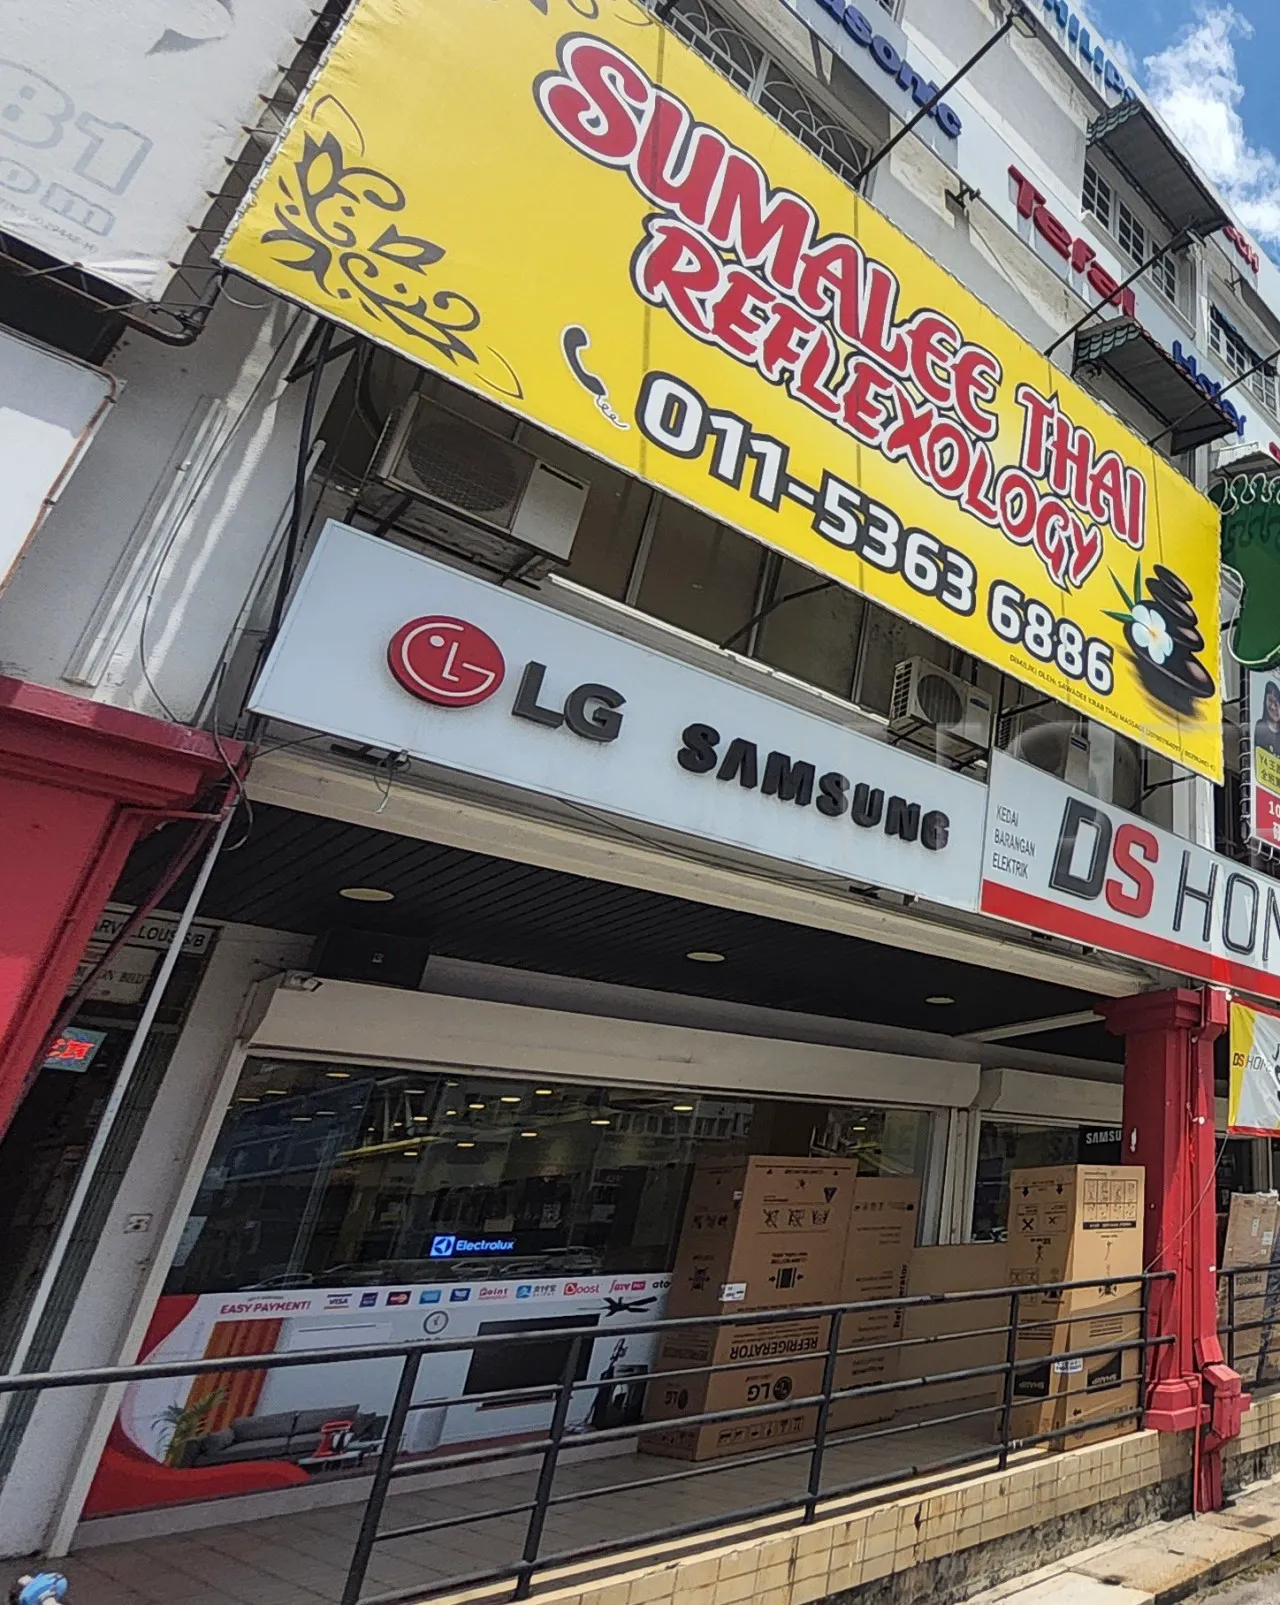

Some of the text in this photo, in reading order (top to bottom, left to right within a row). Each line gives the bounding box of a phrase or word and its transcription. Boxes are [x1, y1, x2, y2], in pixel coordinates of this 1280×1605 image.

[1007, 164, 1136, 320] Tefal
[535, 32, 1146, 550] SUMALEE THAI
[631, 216, 1102, 593] REFLEXOLOGY
[635, 370, 1114, 695] 011-5363 6886
[511, 660, 627, 743] LG
[678, 723, 951, 851] SAMSUNG
[994, 829, 1036, 858] BARANGAN
[996, 804, 1019, 828] KEDAI
[992, 851, 1029, 879] ELEKTRIK
[1048, 796, 1159, 918] DS
[1086, 1130, 1122, 1144] SAMSU
[456, 1239, 515, 1251] Electrolux
[220, 1302, 252, 1314] EASY
[729, 1337, 818, 1360] REFRIGERATOR
